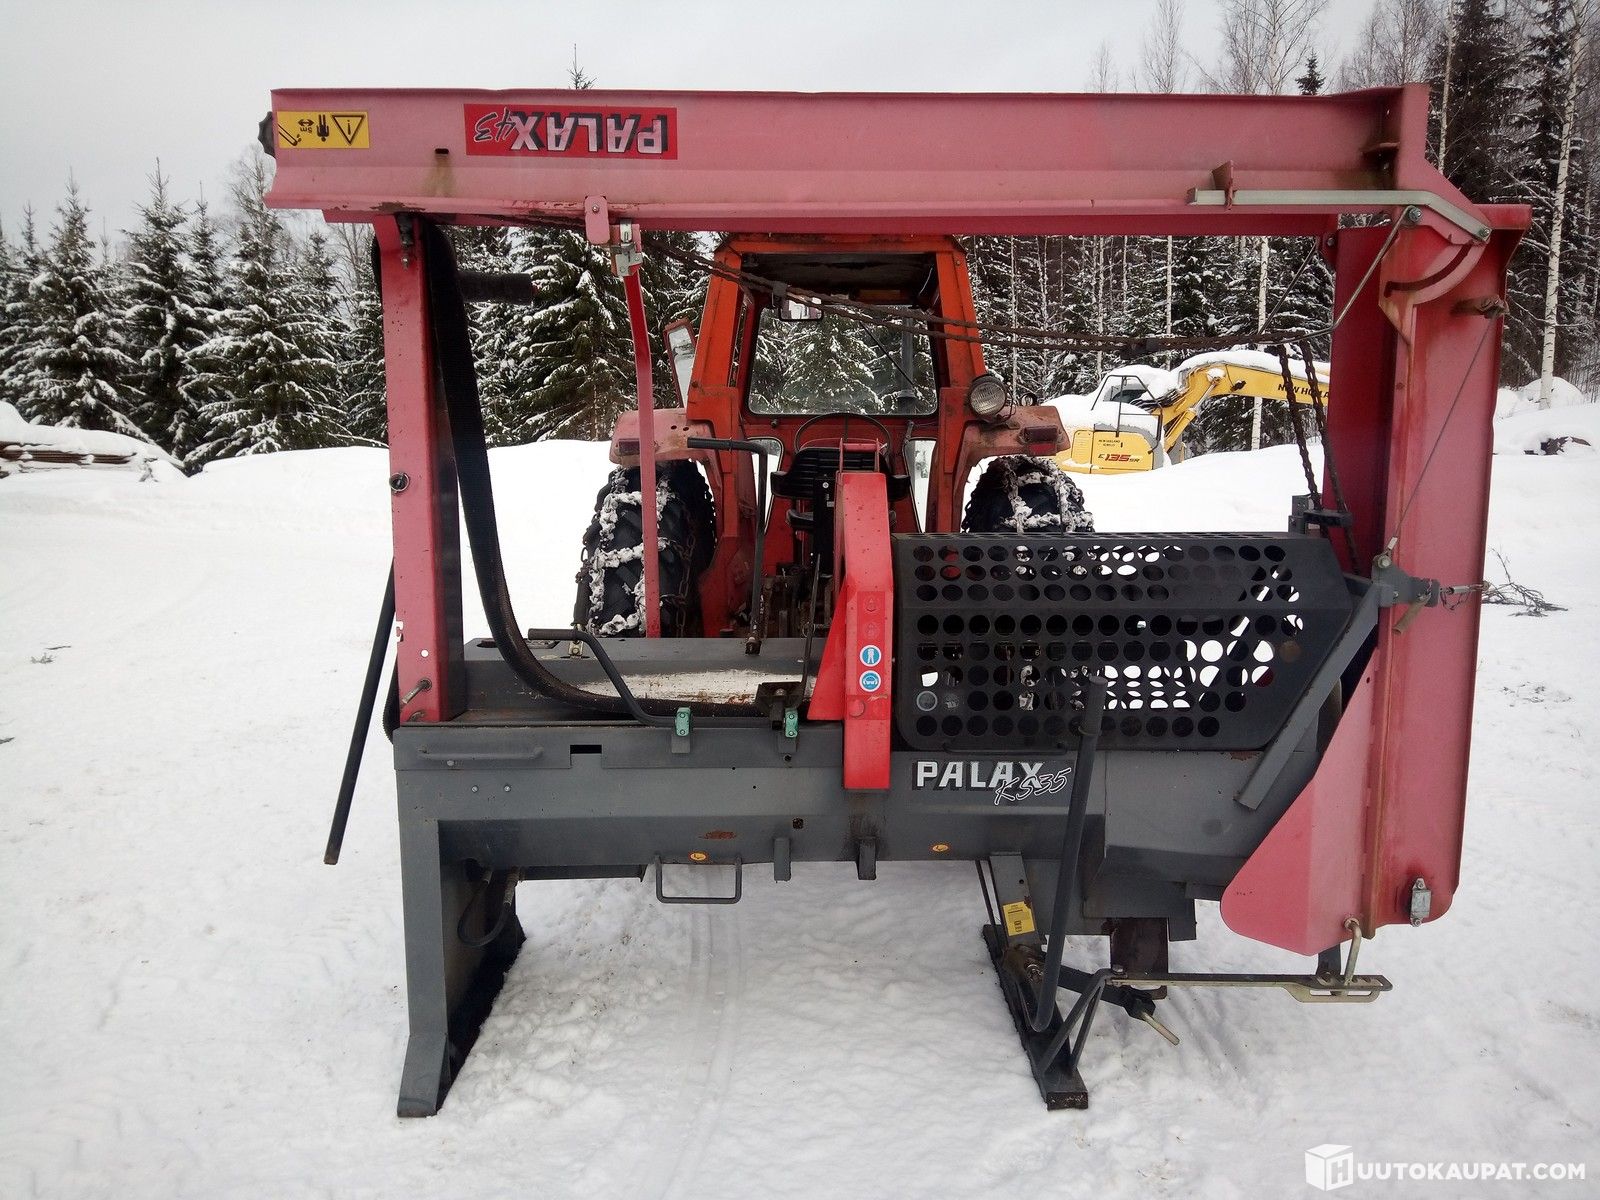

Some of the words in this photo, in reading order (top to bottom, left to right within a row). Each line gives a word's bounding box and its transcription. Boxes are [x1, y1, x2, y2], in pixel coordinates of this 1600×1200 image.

[473, 107, 517, 143] 43
[511, 111, 667, 154] PALAX
[1278, 384, 1300, 393] NW
[914, 760, 1045, 790] PALAX
[994, 767, 1072, 806] KS35
